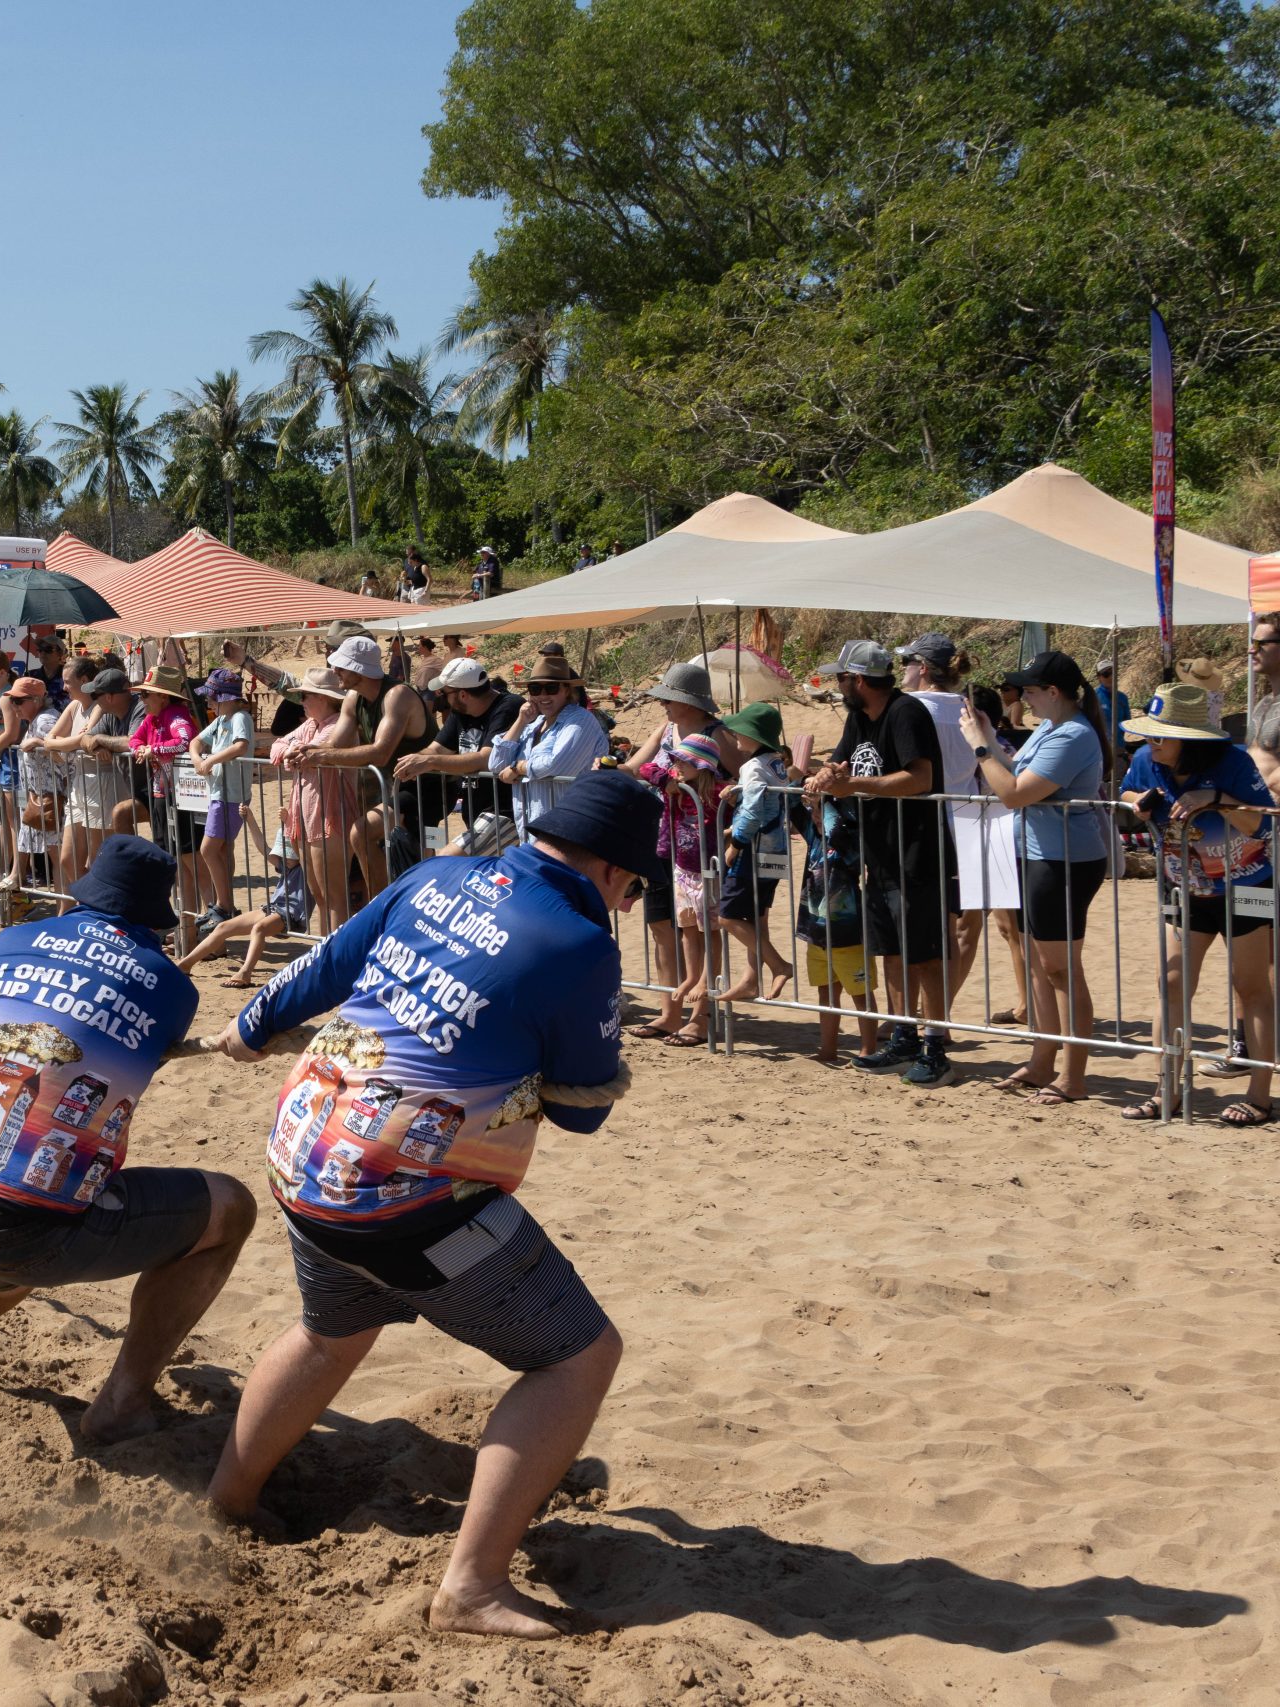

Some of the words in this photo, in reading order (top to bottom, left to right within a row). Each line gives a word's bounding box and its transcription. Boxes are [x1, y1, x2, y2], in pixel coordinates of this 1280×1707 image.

[15, 546, 30, 554] USE
[464, 873, 503, 901] Pauls
[410, 878, 452, 924] Iced
[449, 895, 509, 957] Coffee
[82, 925, 128, 948] Pauls
[414, 919, 448, 945] SINCE
[446, 936, 471, 958] 1961
[31, 931, 85, 956] Iced
[85, 942, 159, 990] Coffee
[48, 952, 94, 969] SINCE
[97, 965, 131, 985] 1961
[13, 963, 91, 993] ONLY
[93, 984, 158, 1037] PICK
[375, 936, 431, 982] ONLY
[425, 964, 491, 1029] PICK
[32, 986, 143, 1050] LOCALS
[375, 979, 462, 1055] LOCALS
[600, 1012, 617, 1039] Iced
[280, 1110, 301, 1142] Iced
[272, 1130, 292, 1167] Coffee
[405, 1146, 426, 1161] Coffee
[381, 1188, 406, 1199] Coffee
